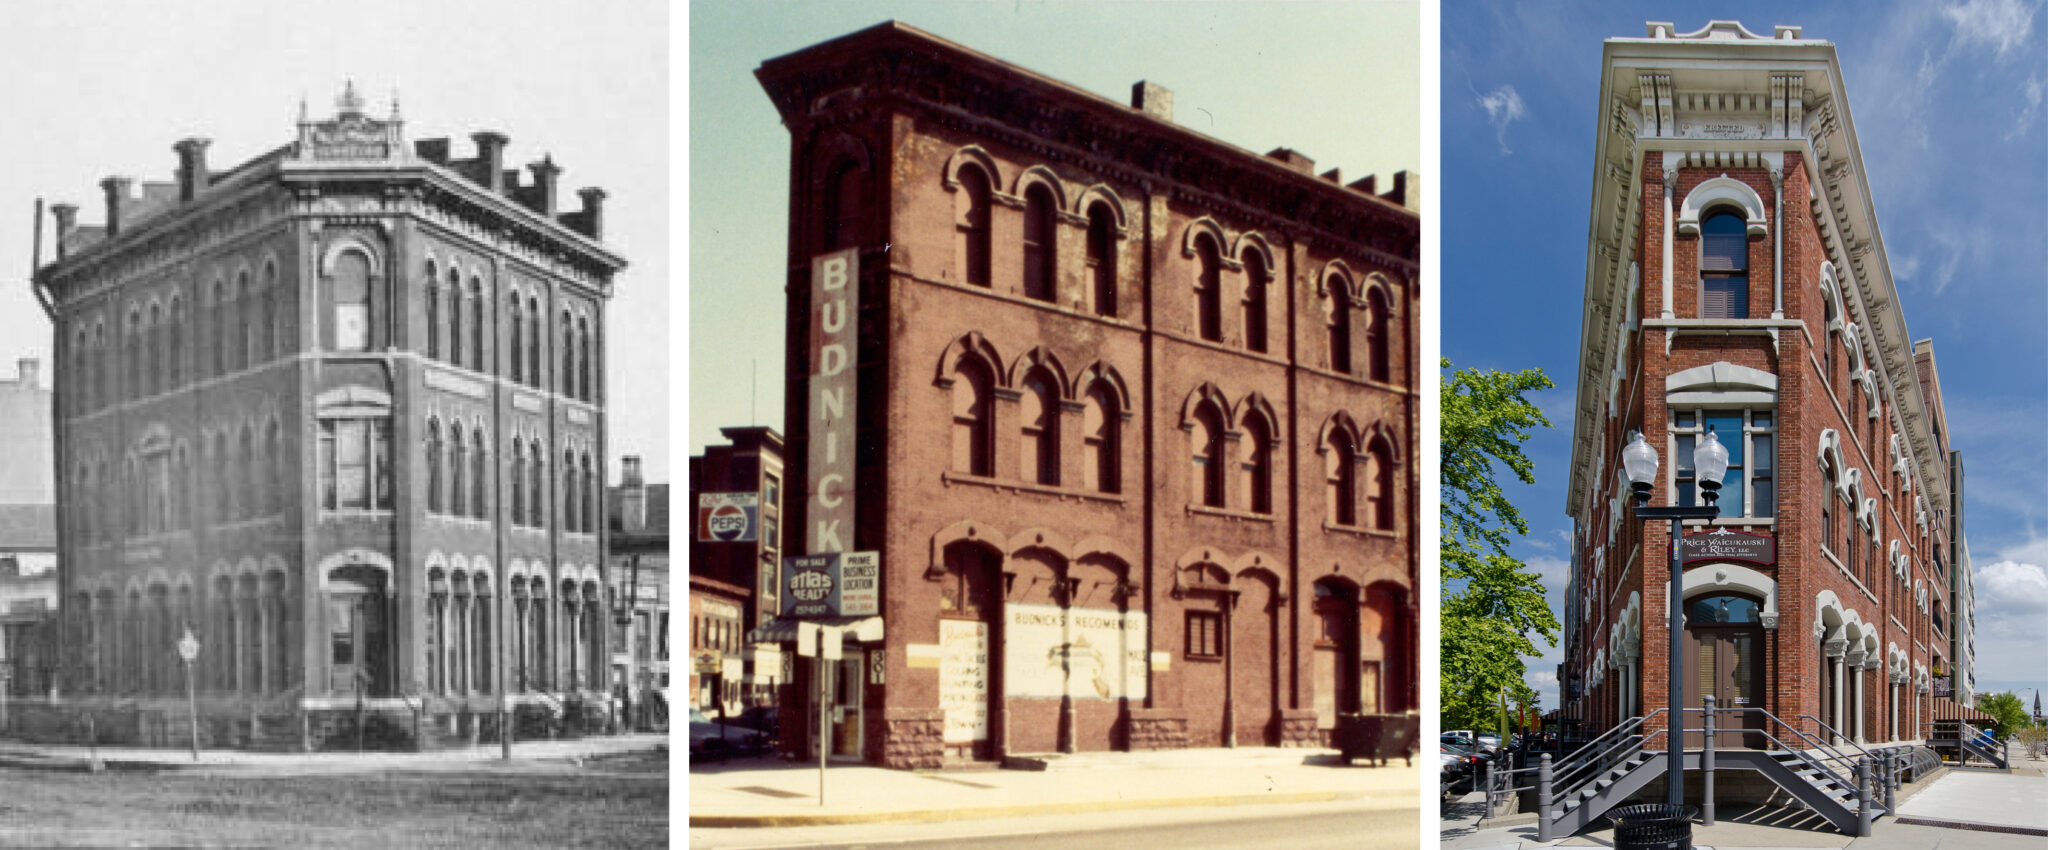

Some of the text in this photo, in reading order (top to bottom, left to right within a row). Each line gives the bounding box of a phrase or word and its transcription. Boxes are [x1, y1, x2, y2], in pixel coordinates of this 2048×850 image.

[818, 257, 848, 552] BUDNICK
[711, 516, 745, 529] PEPSI
[795, 558, 826, 568] FOR SALE
[847, 556, 872, 566] PRIME
[843, 566, 876, 578] BUSINESS
[791, 570, 832, 589] atlas
[843, 579, 873, 591] LOCATION
[793, 589, 831, 601] REALTY
